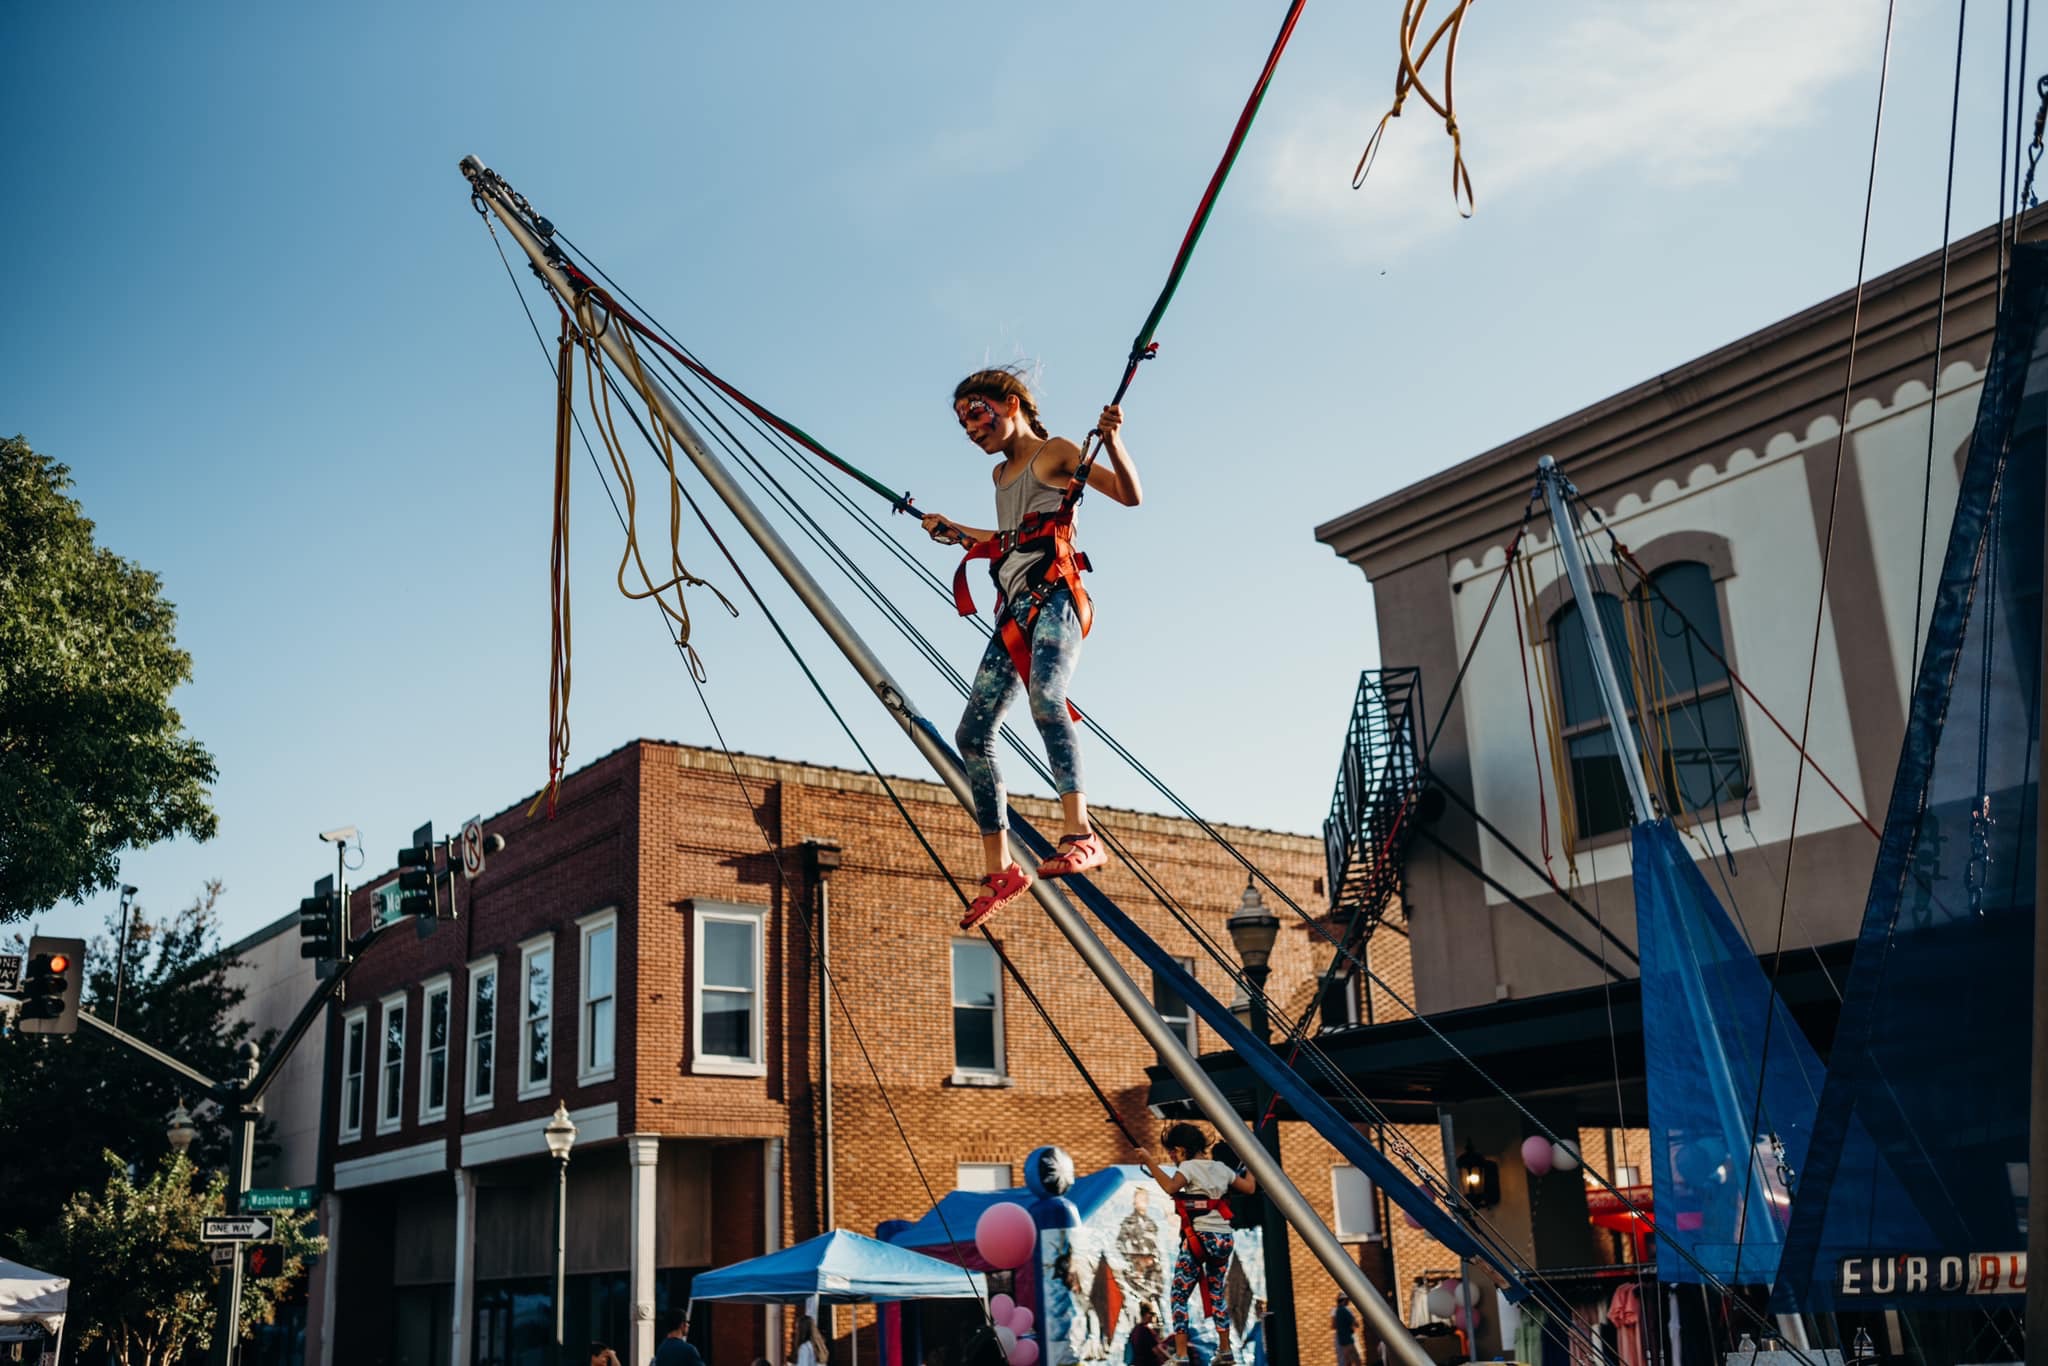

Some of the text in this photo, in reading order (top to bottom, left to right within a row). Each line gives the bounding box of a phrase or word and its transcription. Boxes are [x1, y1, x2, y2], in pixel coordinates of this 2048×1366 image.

[251, 1194, 294, 1207] Washington
[209, 1224, 251, 1233] ONE WAY
